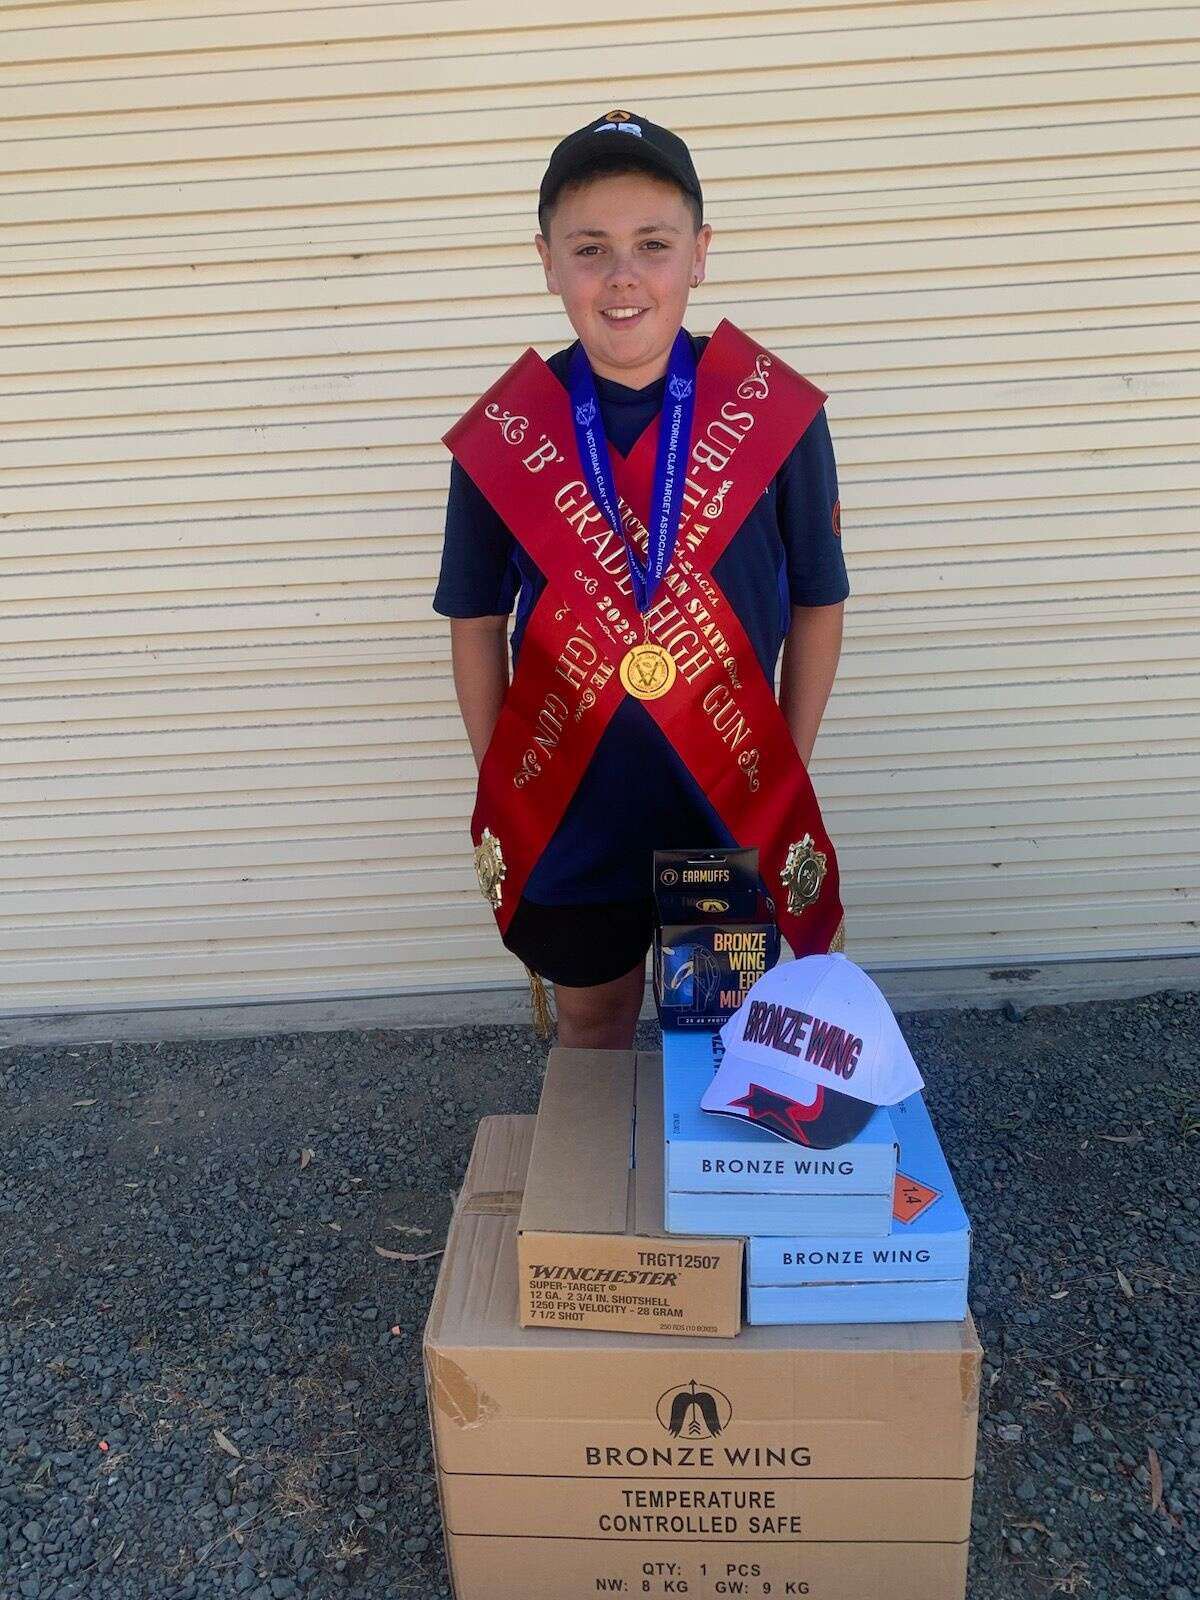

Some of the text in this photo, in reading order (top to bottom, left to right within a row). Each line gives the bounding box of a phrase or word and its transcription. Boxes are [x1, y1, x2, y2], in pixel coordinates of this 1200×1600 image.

[586, 429, 600, 477] VICTORIAN
[596, 475, 608, 500] CLAY
[655, 404, 682, 578] VICTORIAN CLAY TARGET ASSOCIATION
[596, 596, 638, 646] 2023
[685, 598, 731, 659] STATE
[555, 622, 597, 690] IGH
[643, 595, 714, 685] HIGH
[702, 683, 753, 752] GUN
[533, 693, 568, 759] GUN
[682, 869, 730, 883] EARMUFFS
[713, 932, 767, 951] BRONZE
[729, 951, 766, 971] WING
[743, 1000, 813, 1057] BRONZE
[804, 1018, 863, 1080] WING
[702, 1159, 854, 1176] BRONZE WING
[902, 1186, 922, 1204] 1.4
[637, 1252, 720, 1270] TRGT12507
[783, 1250, 930, 1266] BRONZE WING
[528, 1264, 681, 1287] WINCHESTER
[529, 1280, 607, 1293] SUPER-TARGET
[530, 1291, 671, 1307] 12 GA. 2 3/4 IN. SHOTSHELL
[530, 1301, 555, 1310] 1250
[557, 1302, 576, 1311] FPS
[578, 1303, 627, 1314] VELOCITY
[637, 1306, 651, 1316] 28
[652, 1307, 684, 1318] GRAM
[530, 1310, 585, 1321] 7 1/2 SHOT
[585, 1446, 812, 1467] BRONZE WING
[622, 1489, 776, 1509] TEMPERATURE
[599, 1514, 802, 1534] CONTROLLED SAFE
[642, 1562, 761, 1577] QTY: 1 PCS
[596, 1578, 810, 1595] NW: 8 KG GW: 9 KG
